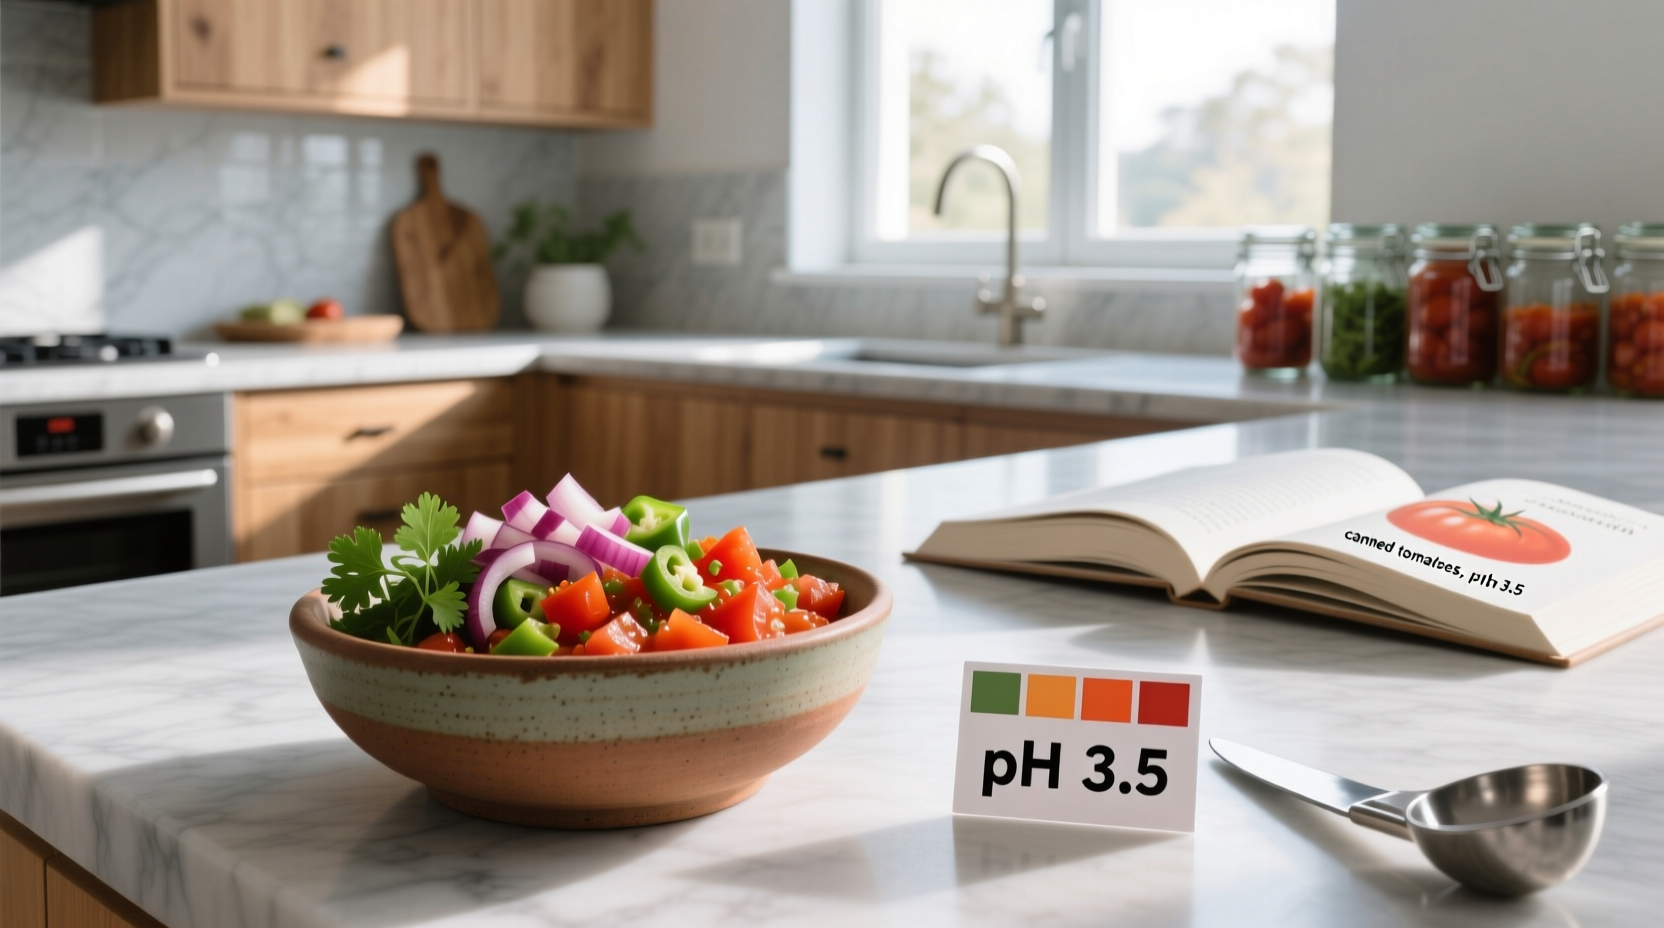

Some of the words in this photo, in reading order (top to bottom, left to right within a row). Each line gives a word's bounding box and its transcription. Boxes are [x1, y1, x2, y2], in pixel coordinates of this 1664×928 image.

[1344, 530, 1396, 553] canned
[1499, 579, 1525, 596] 3.5
[981, 739, 1062, 797] pH
[1081, 744, 1168, 797] 3.5
